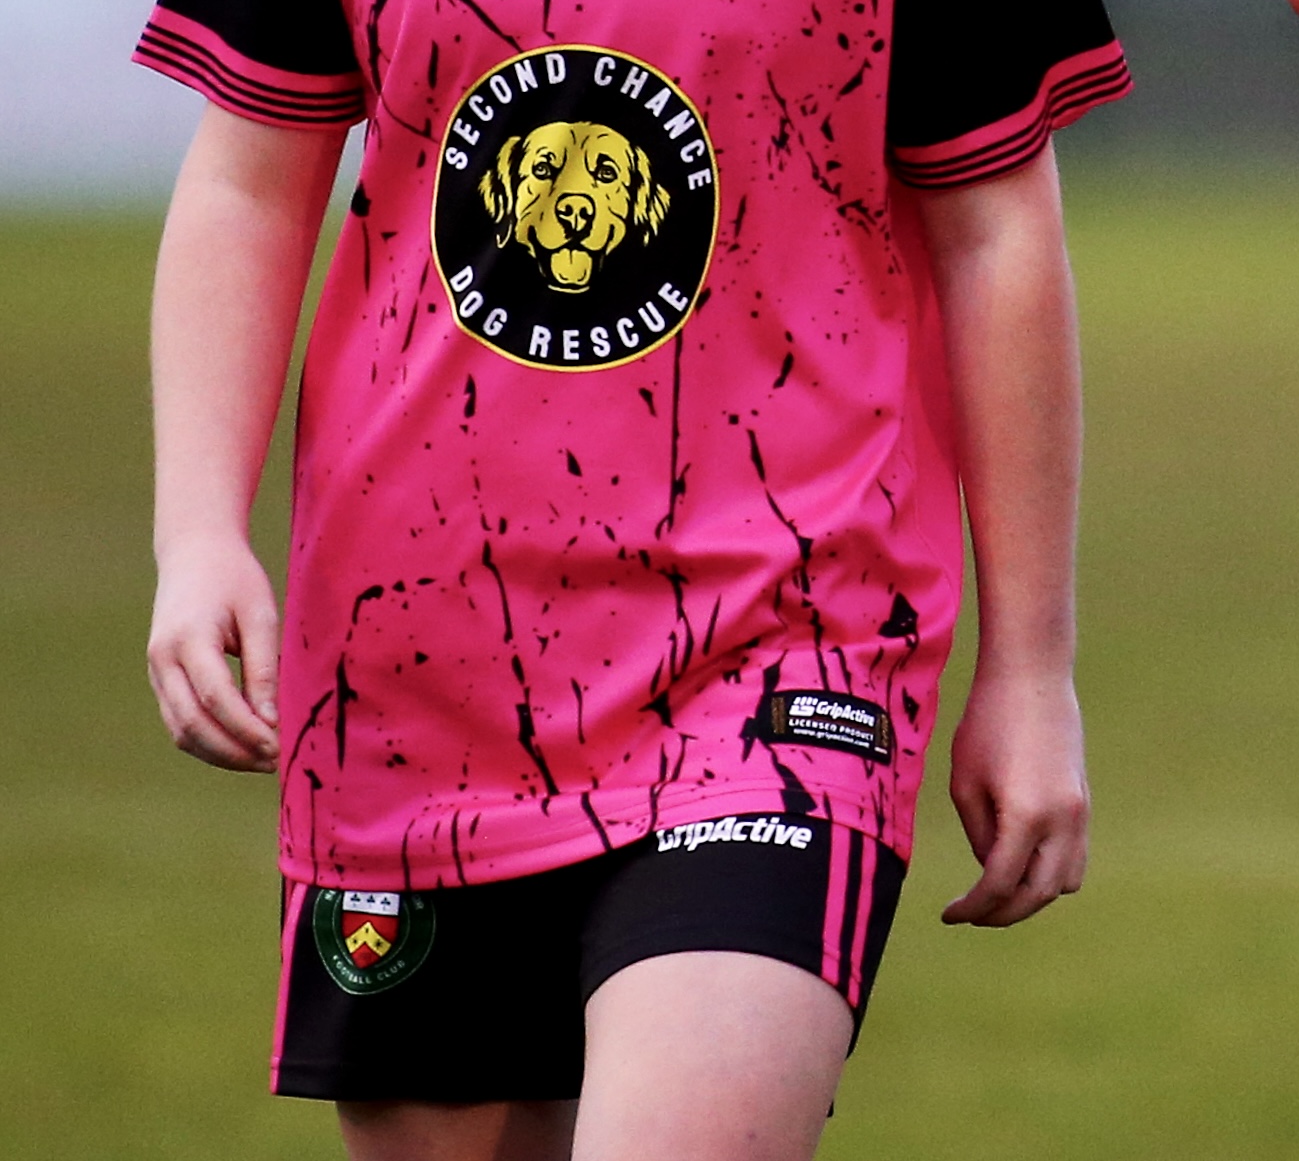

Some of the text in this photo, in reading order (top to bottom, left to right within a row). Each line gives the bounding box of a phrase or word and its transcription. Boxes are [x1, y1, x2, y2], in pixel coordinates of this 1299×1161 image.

[446, 52, 713, 191] SECOND CHANCE
[449, 265, 690, 361] DOG RESCUE
[788, 718, 838, 733] LICENSED
[816, 701, 875, 727] GripActive
[376, 960, 406, 982] CLUB
